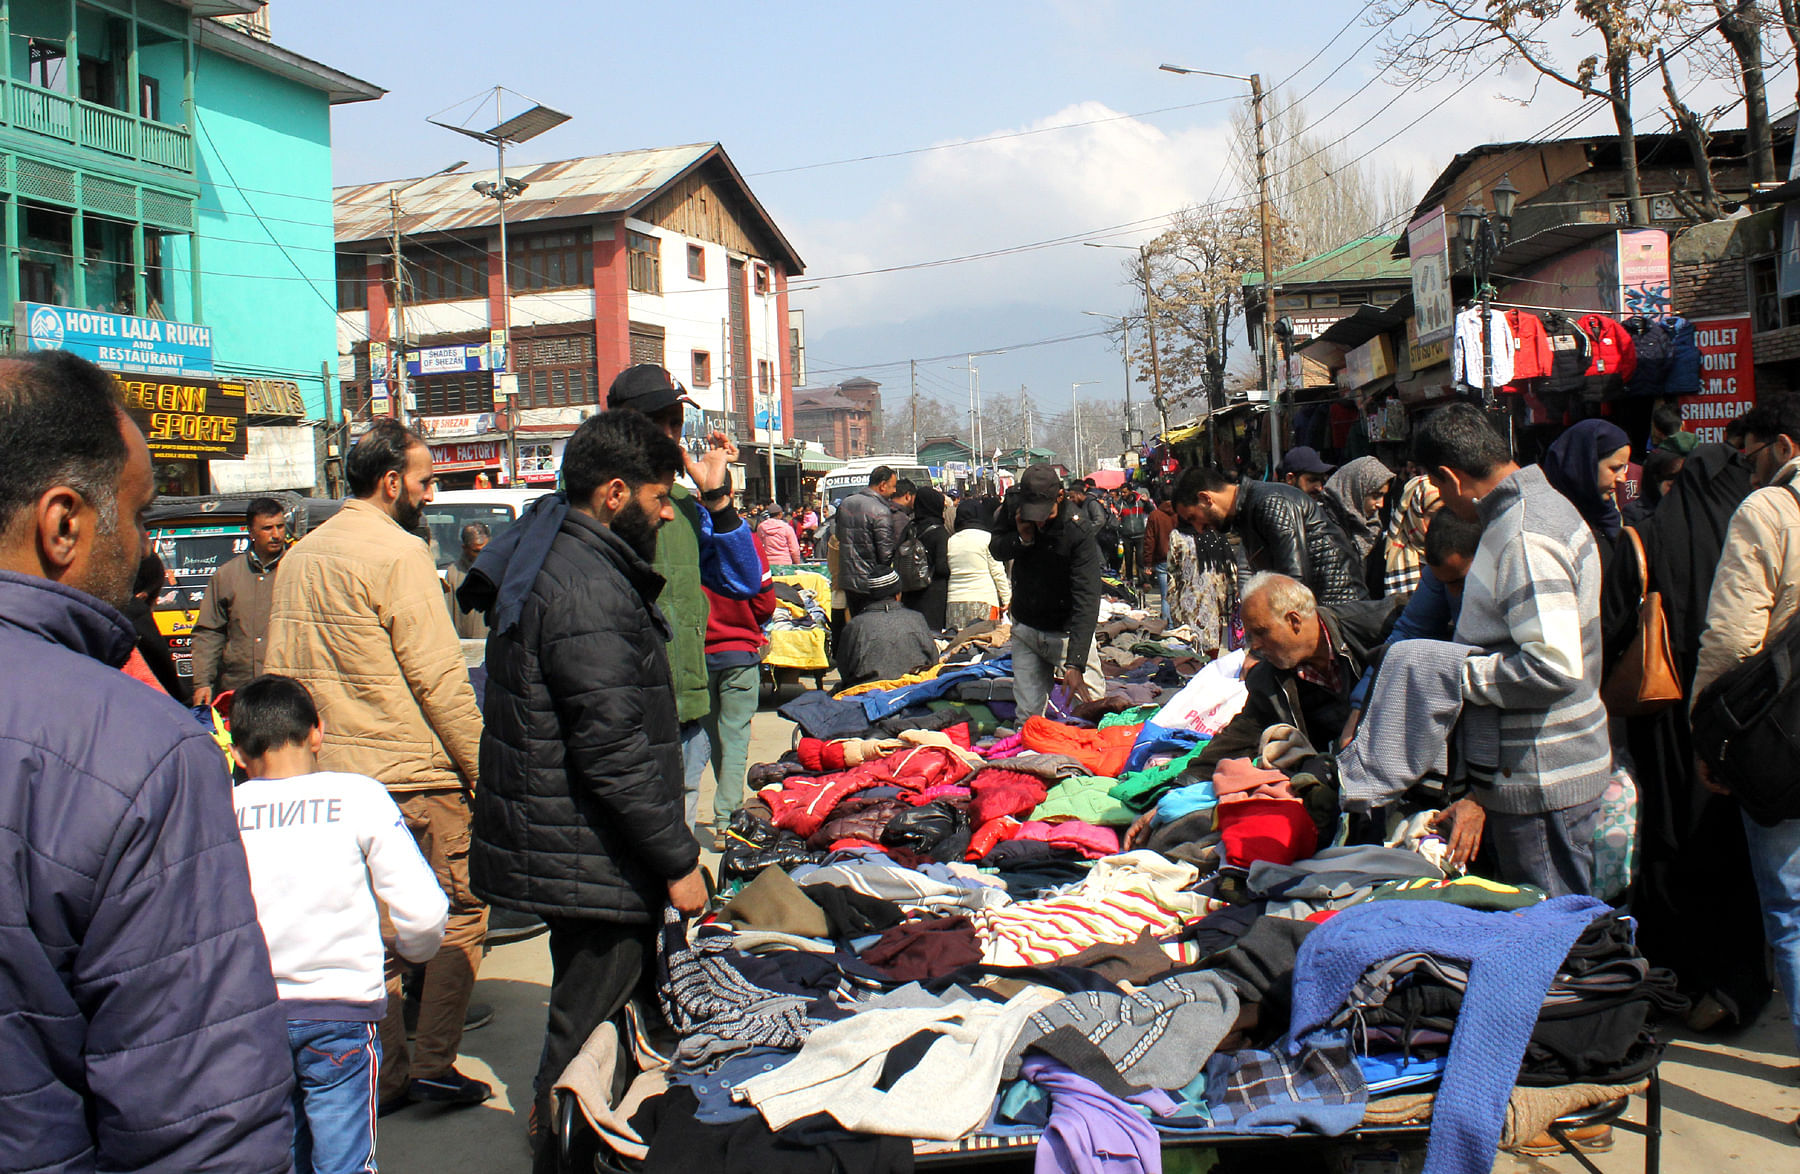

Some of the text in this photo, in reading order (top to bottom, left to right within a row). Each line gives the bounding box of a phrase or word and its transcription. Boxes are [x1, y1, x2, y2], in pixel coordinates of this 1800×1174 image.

[66, 311, 210, 348] HOTEL LALA RUKH
[1694, 328, 1738, 348] TOILET
[132, 340, 154, 350] AND
[428, 349, 458, 358] SHADES
[99, 346, 185, 368] RESTAURANT
[423, 356, 463, 368] OF SHEZAN
[1700, 352, 1737, 371] OINT
[1698, 377, 1737, 395] S.M.C
[157, 384, 207, 414] ENN
[150, 412, 239, 443] SPORTS
[440, 417, 469, 429] SHEZAN
[1695, 427, 1726, 444] GEN
[456, 442, 496, 461] FACTORY
